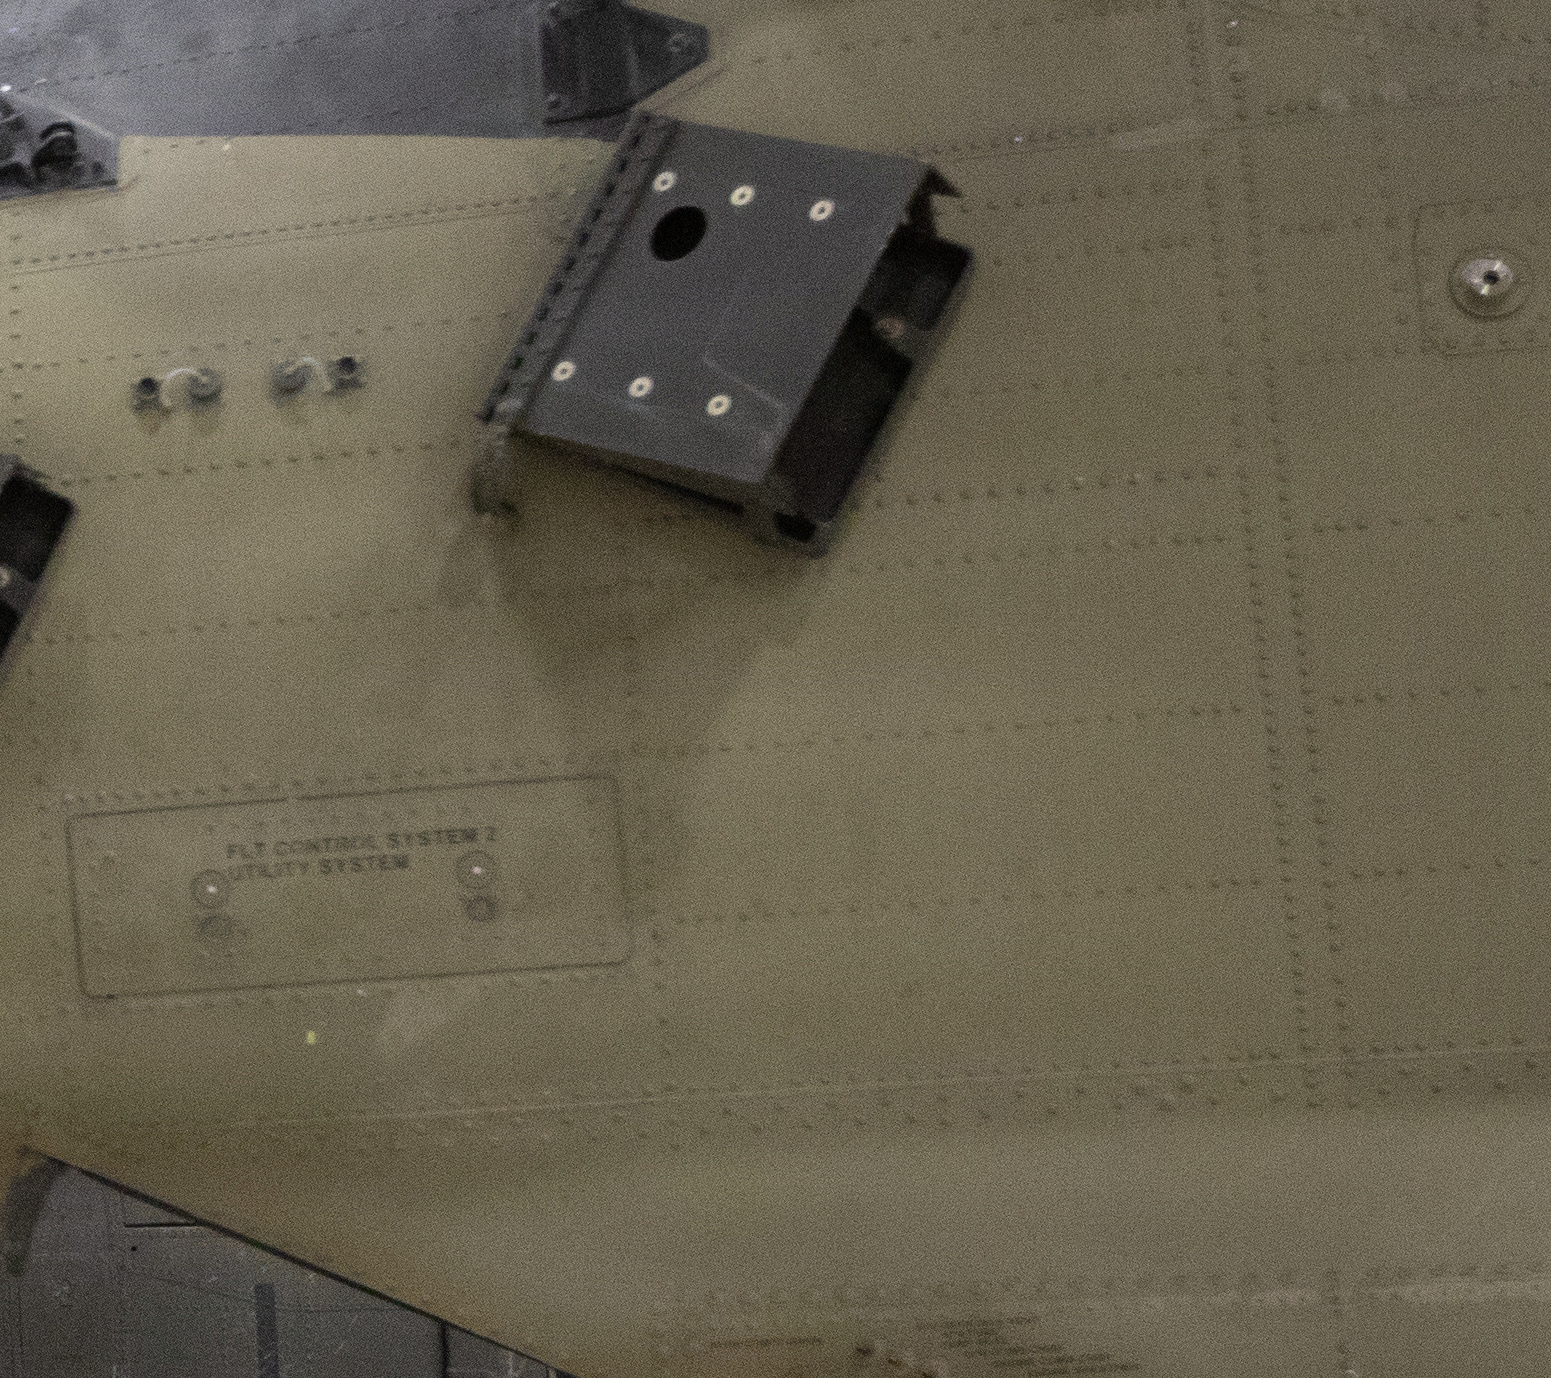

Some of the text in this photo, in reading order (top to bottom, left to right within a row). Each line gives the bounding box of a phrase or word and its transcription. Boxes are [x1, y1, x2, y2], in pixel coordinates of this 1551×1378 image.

[226, 840, 266, 860] FLT
[273, 834, 379, 857] CONTROL
[386, 827, 478, 850] SYSTEM
[228, 853, 411, 883] UTILITY SYSTEM
